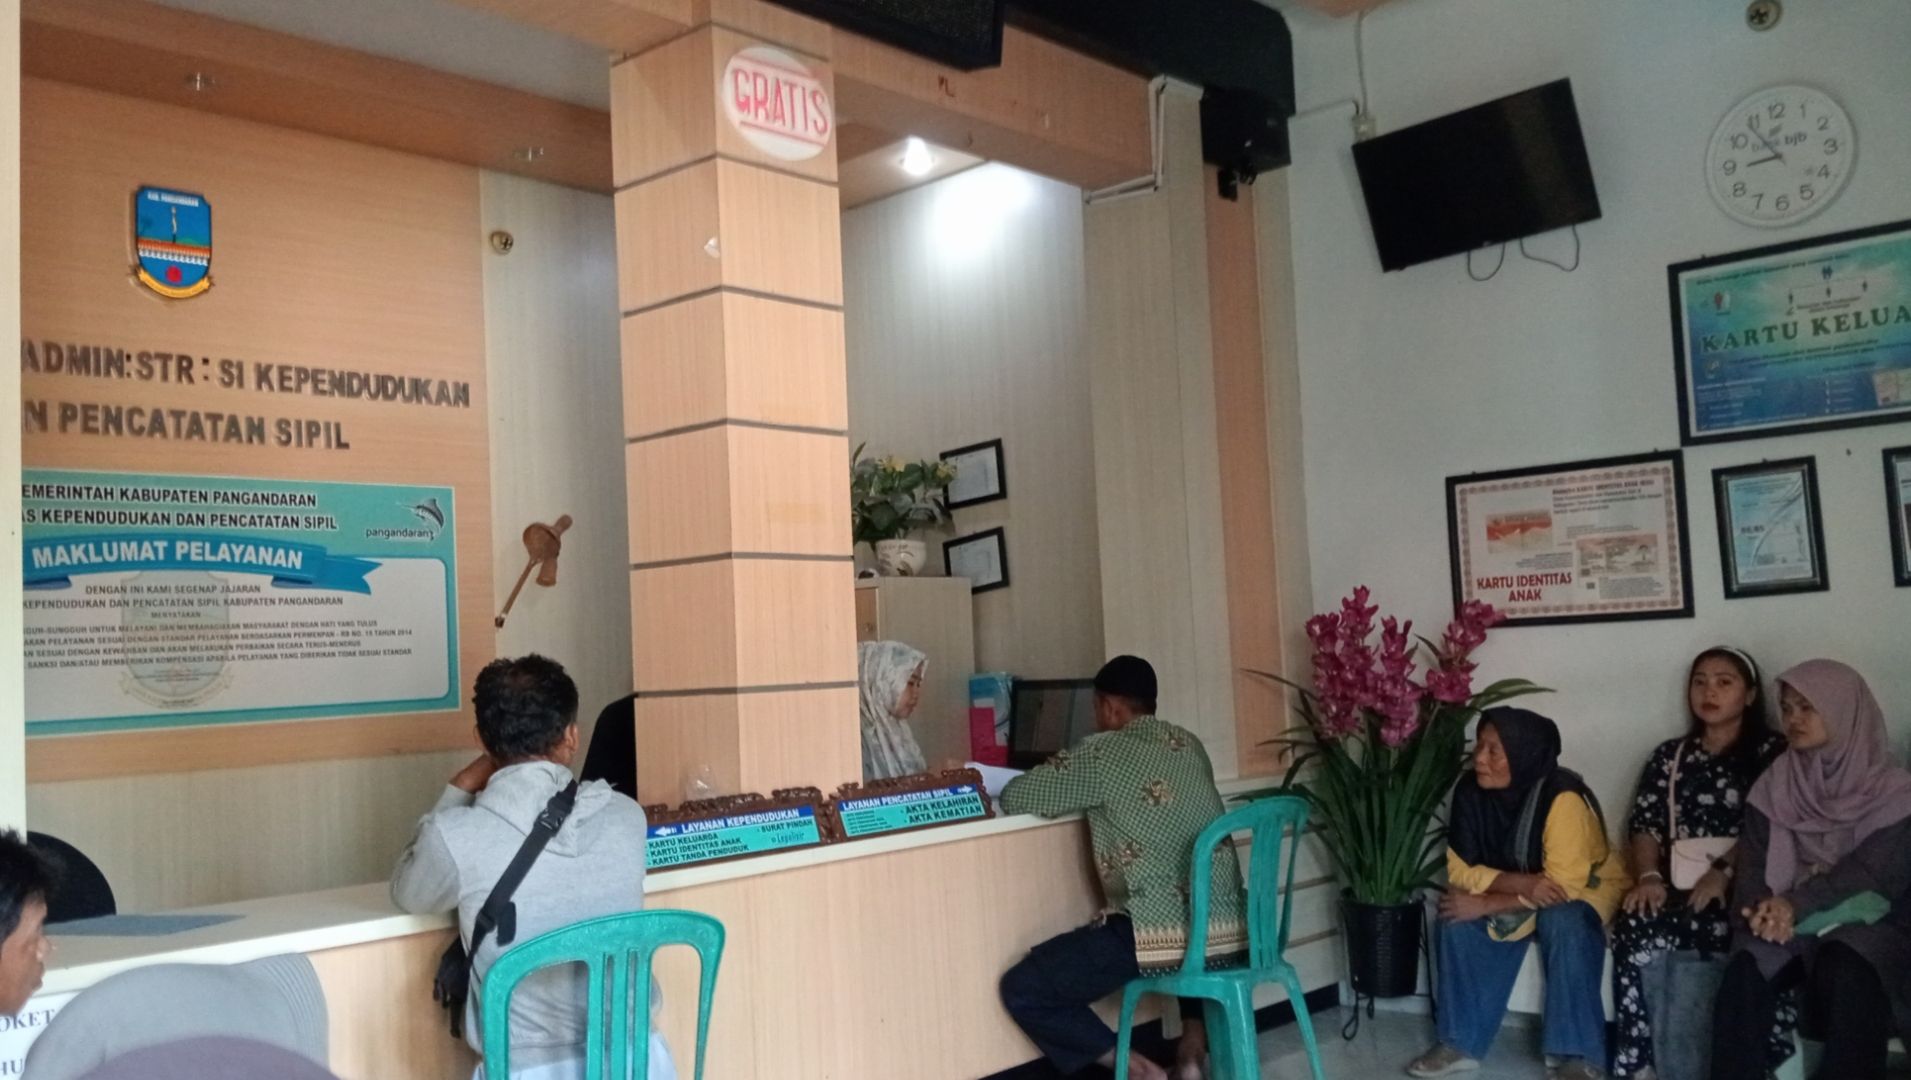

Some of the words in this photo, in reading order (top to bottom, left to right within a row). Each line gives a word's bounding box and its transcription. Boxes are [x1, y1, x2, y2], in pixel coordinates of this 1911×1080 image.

[733, 68, 828, 135] GRATIS
[1768, 103, 1785, 120] 12
[1800, 104, 1806, 118] 1
[1817, 117, 1829, 131] 2
[1731, 133, 1748, 150] 10
[1824, 138, 1838, 155] 3
[1723, 160, 1737, 176] 9
[1817, 164, 1830, 179] 4
[1732, 182, 1746, 197] 8
[1800, 184, 1814, 200] 5
[1752, 193, 1764, 210] 7
[1775, 195, 1790, 211] 6
[1702, 321, 1799, 352] KARTU
[1812, 303, 1911, 336] KELUA
[255, 362, 471, 408] KEPENDUDUKAN
[58, 402, 266, 446] PENCATATAN
[275, 418, 350, 450] SIPIL
[22, 485, 114, 500] EMERINTAH
[120, 488, 208, 503] KABUPATEN
[213, 491, 316, 507] PANGANDARAN
[42, 509, 171, 526] KEPENDUDUKAN
[176, 512, 205, 527] DAN
[210, 514, 299, 529] PENCATATAN
[304, 518, 337, 530] SIPIL
[366, 528, 429, 540] pangandaran
[32, 541, 168, 569] MAKLUMAT
[175, 541, 303, 570] PELAYANAN
[1477, 574, 1513, 590] KARTU
[1517, 571, 1573, 588] IDENTITAS
[85, 585, 127, 594] DENGAN
[130, 585, 144, 594] INI
[147, 585, 171, 593] KAMI
[175, 585, 217, 593] SEGENAP
[220, 585, 260, 593] JAJARAN
[1508, 589, 1542, 603] ANAK
[109, 599, 129, 608] DAN
[133, 598, 194, 608] PENCATATAN
[197, 598, 220, 607] SIPIL
[223, 597, 276, 606] KABUPATEN
[279, 597, 343, 606] PANGANDARAN
[842, 798, 881, 811] LAYANAN
[882, 790, 932, 805] PENCATATAN
[932, 788, 953, 799] SIPIL
[906, 803, 930, 814] AKTA
[931, 796, 979, 811] KELAHIRAN
[681, 819, 726, 834] LAYANAN
[726, 808, 800, 829] KEPENDUDUKAN
[909, 813, 932, 824] AKTA
[934, 805, 982, 820] KEMATIAN
[761, 823, 785, 833] SURAT
[649, 839, 677, 849] KARTU
[678, 833, 718, 845] KELUARGA
[651, 848, 678, 858] KARTU
[680, 841, 719, 853] IDENTITAS
[721, 837, 742, 847] ANAK
[653, 856, 680, 866] KARTU
[681, 850, 708, 861] TANDA
[708, 845, 749, 858] PENDUDUK
